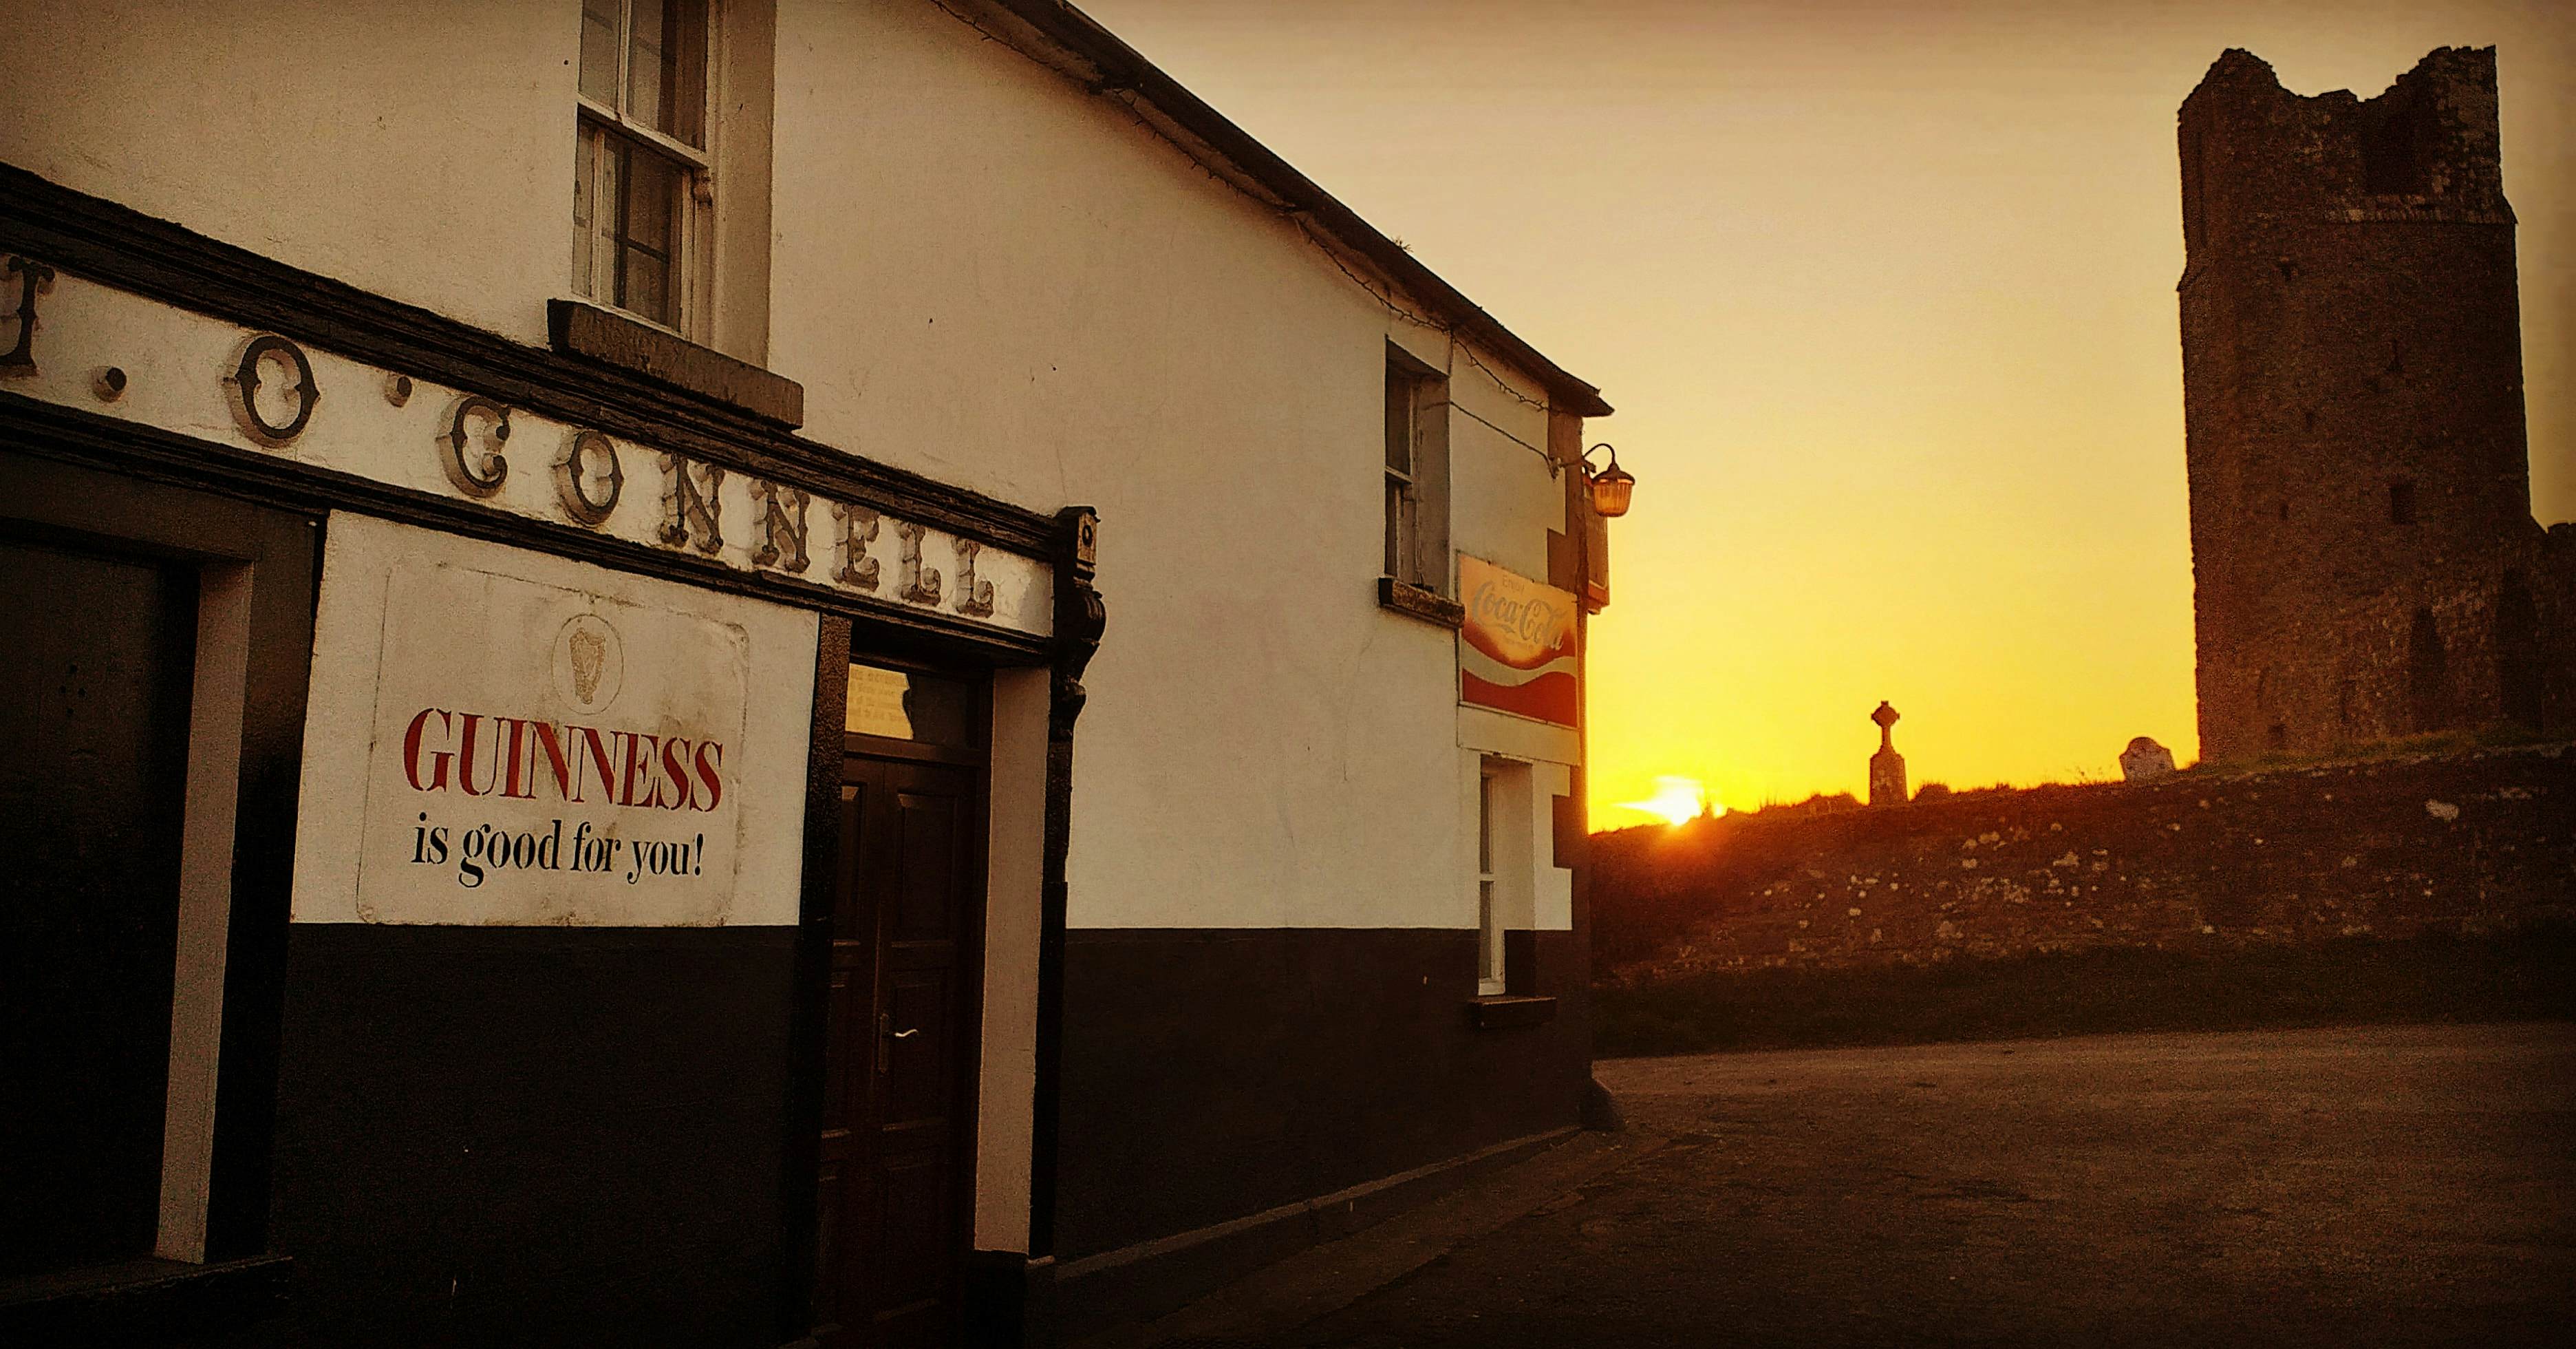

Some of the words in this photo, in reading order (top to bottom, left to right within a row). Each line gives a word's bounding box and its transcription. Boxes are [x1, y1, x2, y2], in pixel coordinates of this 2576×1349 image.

[1472, 581, 1567, 651] Coca-Cola
[403, 708, 723, 811] GUINNESS
[411, 812, 449, 865] is
[458, 820, 562, 888] good
[570, 821, 621, 875] for
[626, 833, 705, 885] you!
